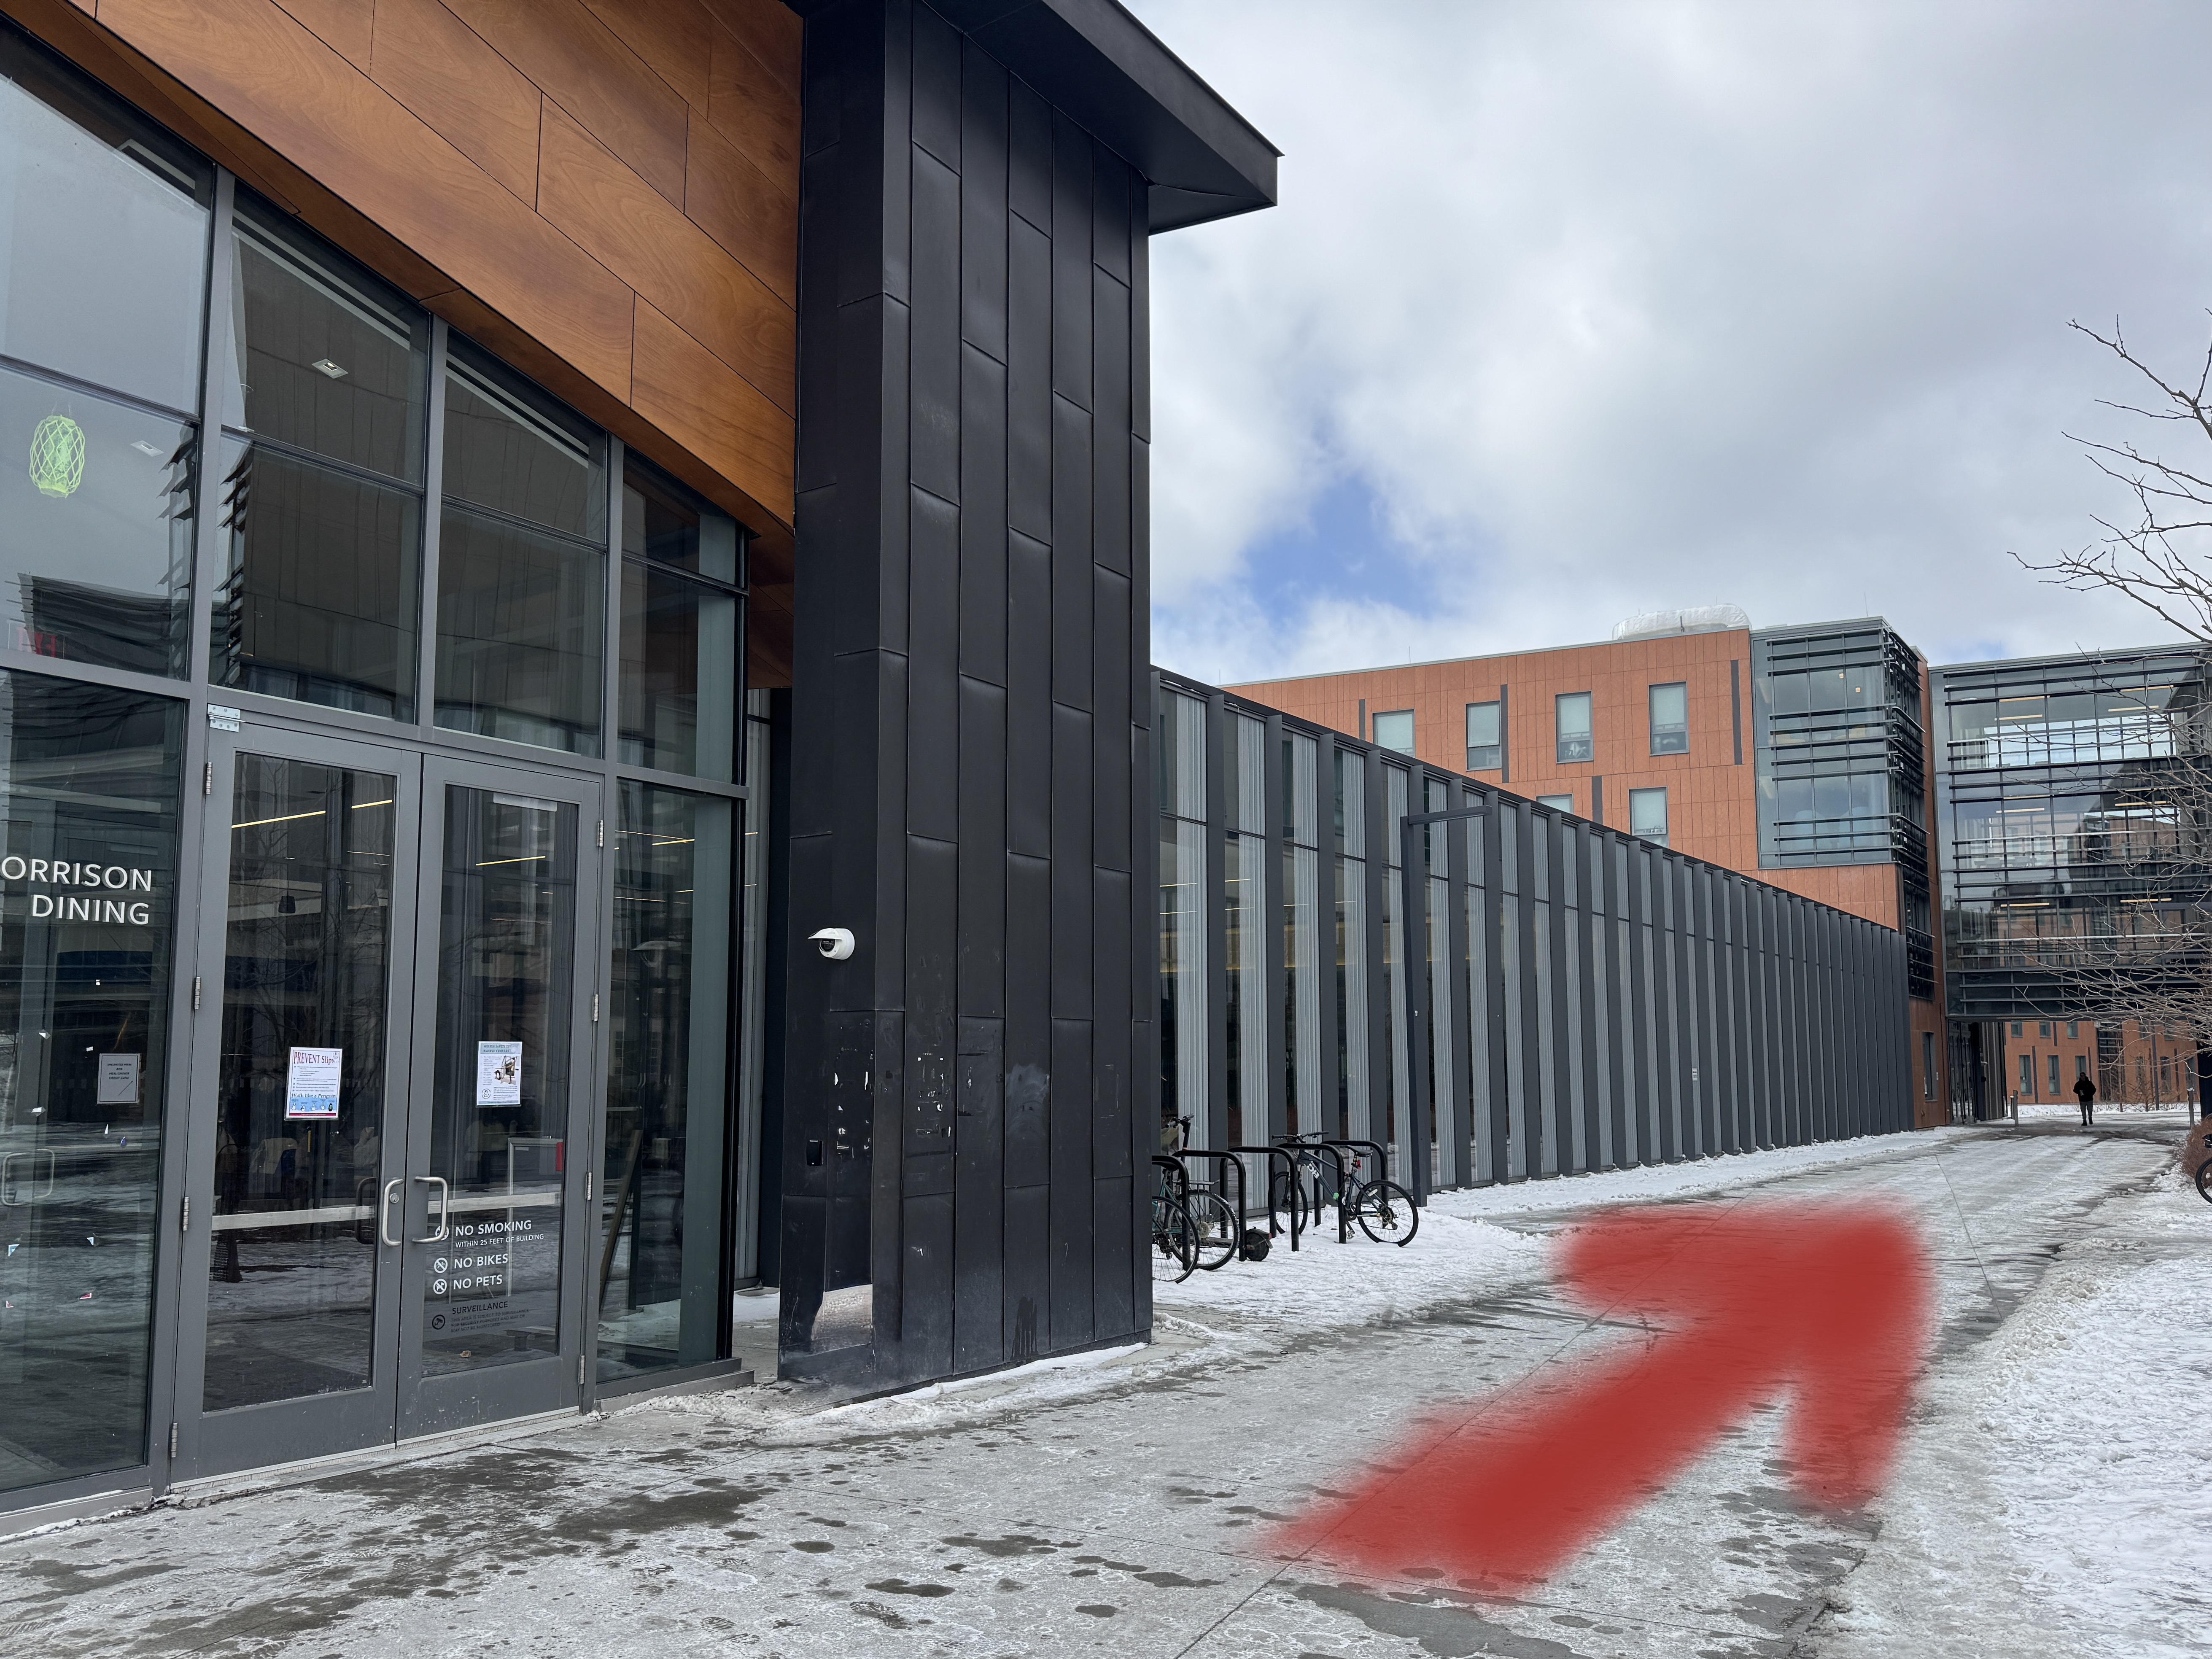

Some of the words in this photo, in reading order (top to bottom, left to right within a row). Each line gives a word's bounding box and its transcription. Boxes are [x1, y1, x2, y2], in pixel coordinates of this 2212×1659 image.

[1, 856, 151, 891] ORRISON
[32, 894, 149, 925] DINING
[294, 1051, 320, 1064] PREVENT
[455, 1225, 474, 1236] NO
[478, 1220, 531, 1234] SMOKING
[454, 1258, 472, 1269] NO
[477, 1253, 508, 1266] BIKES
[453, 1278, 471, 1290] NO
[476, 1274, 502, 1287] PETS
[452, 1301, 508, 1314] SURVEILLANCE
